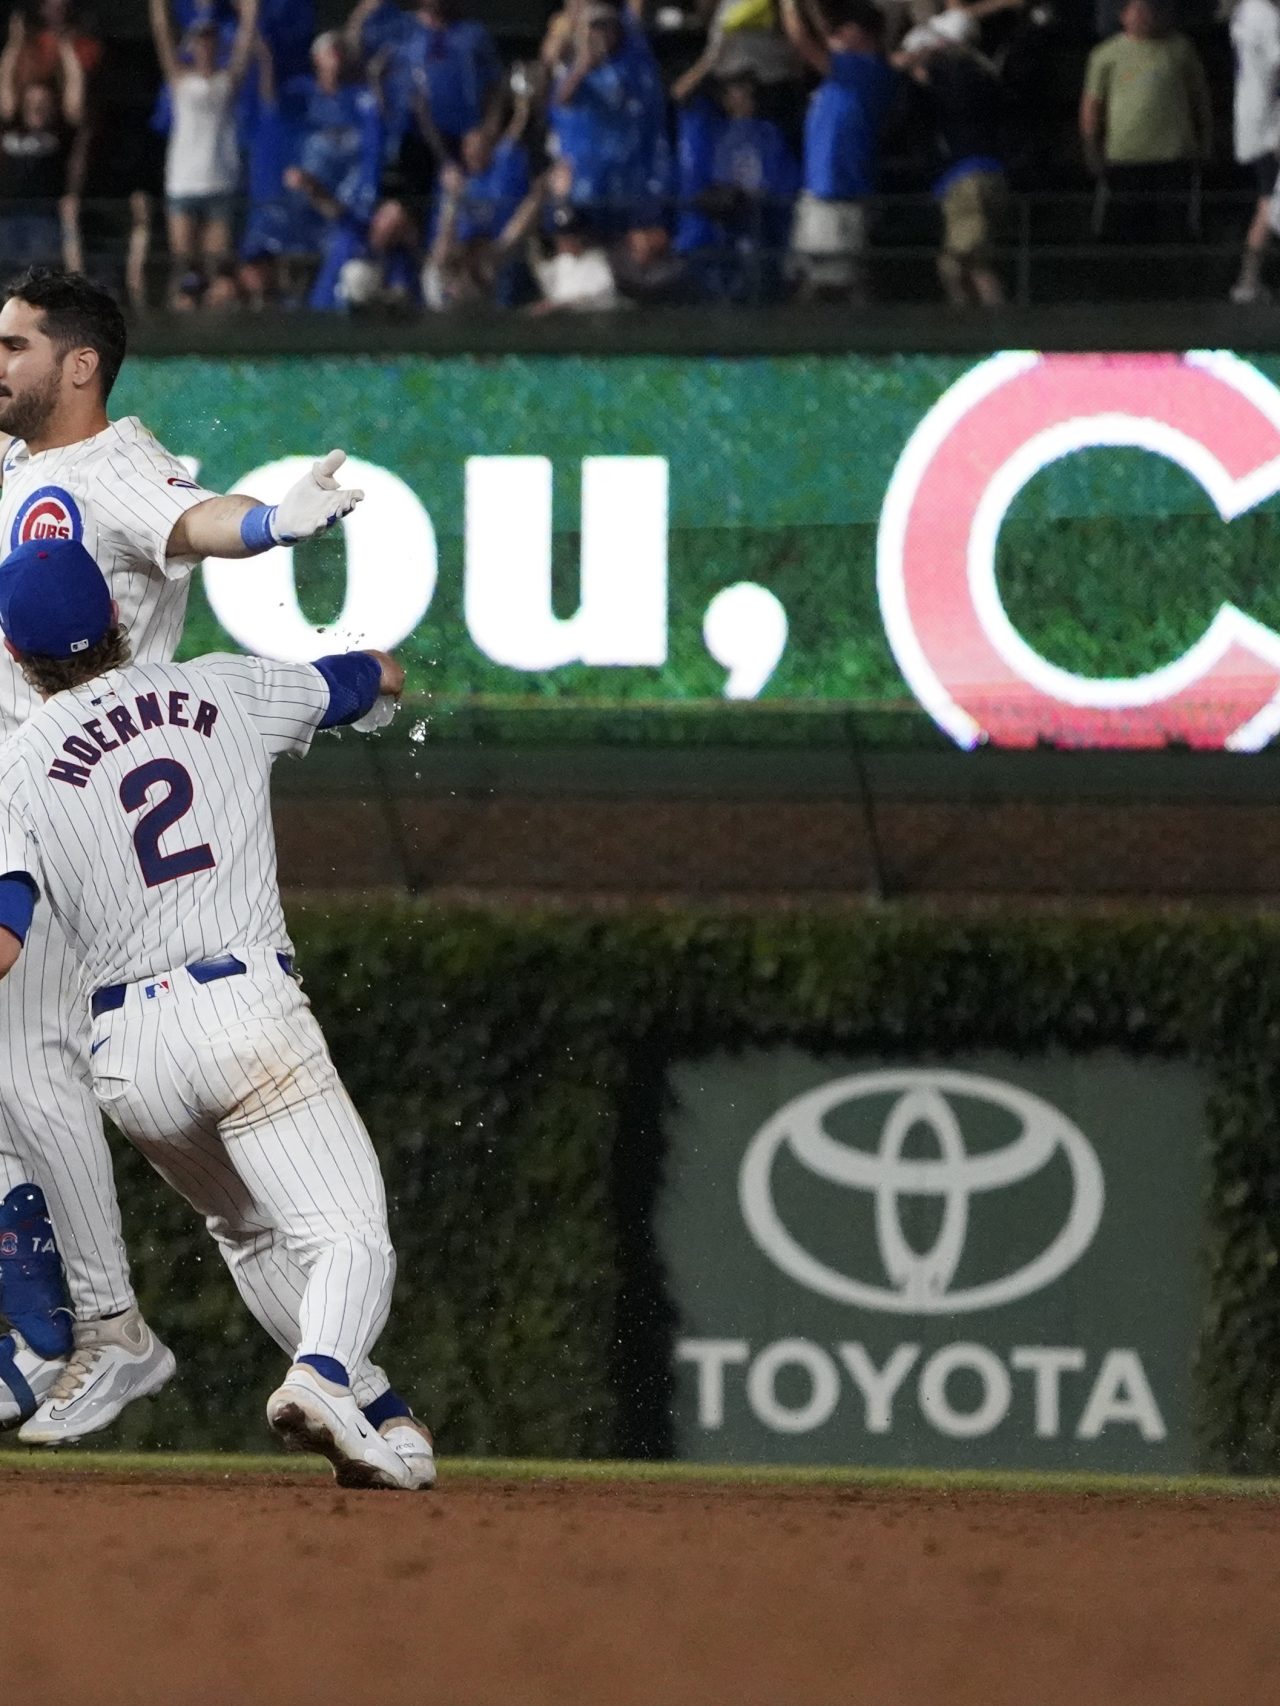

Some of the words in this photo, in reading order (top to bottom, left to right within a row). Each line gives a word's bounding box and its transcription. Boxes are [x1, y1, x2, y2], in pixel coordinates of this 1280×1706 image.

[178, 455, 788, 699] OU,
[48, 690, 218, 788] HOERNER
[119, 757, 216, 888] 2
[674, 1337, 1167, 1441] TOYOTA
